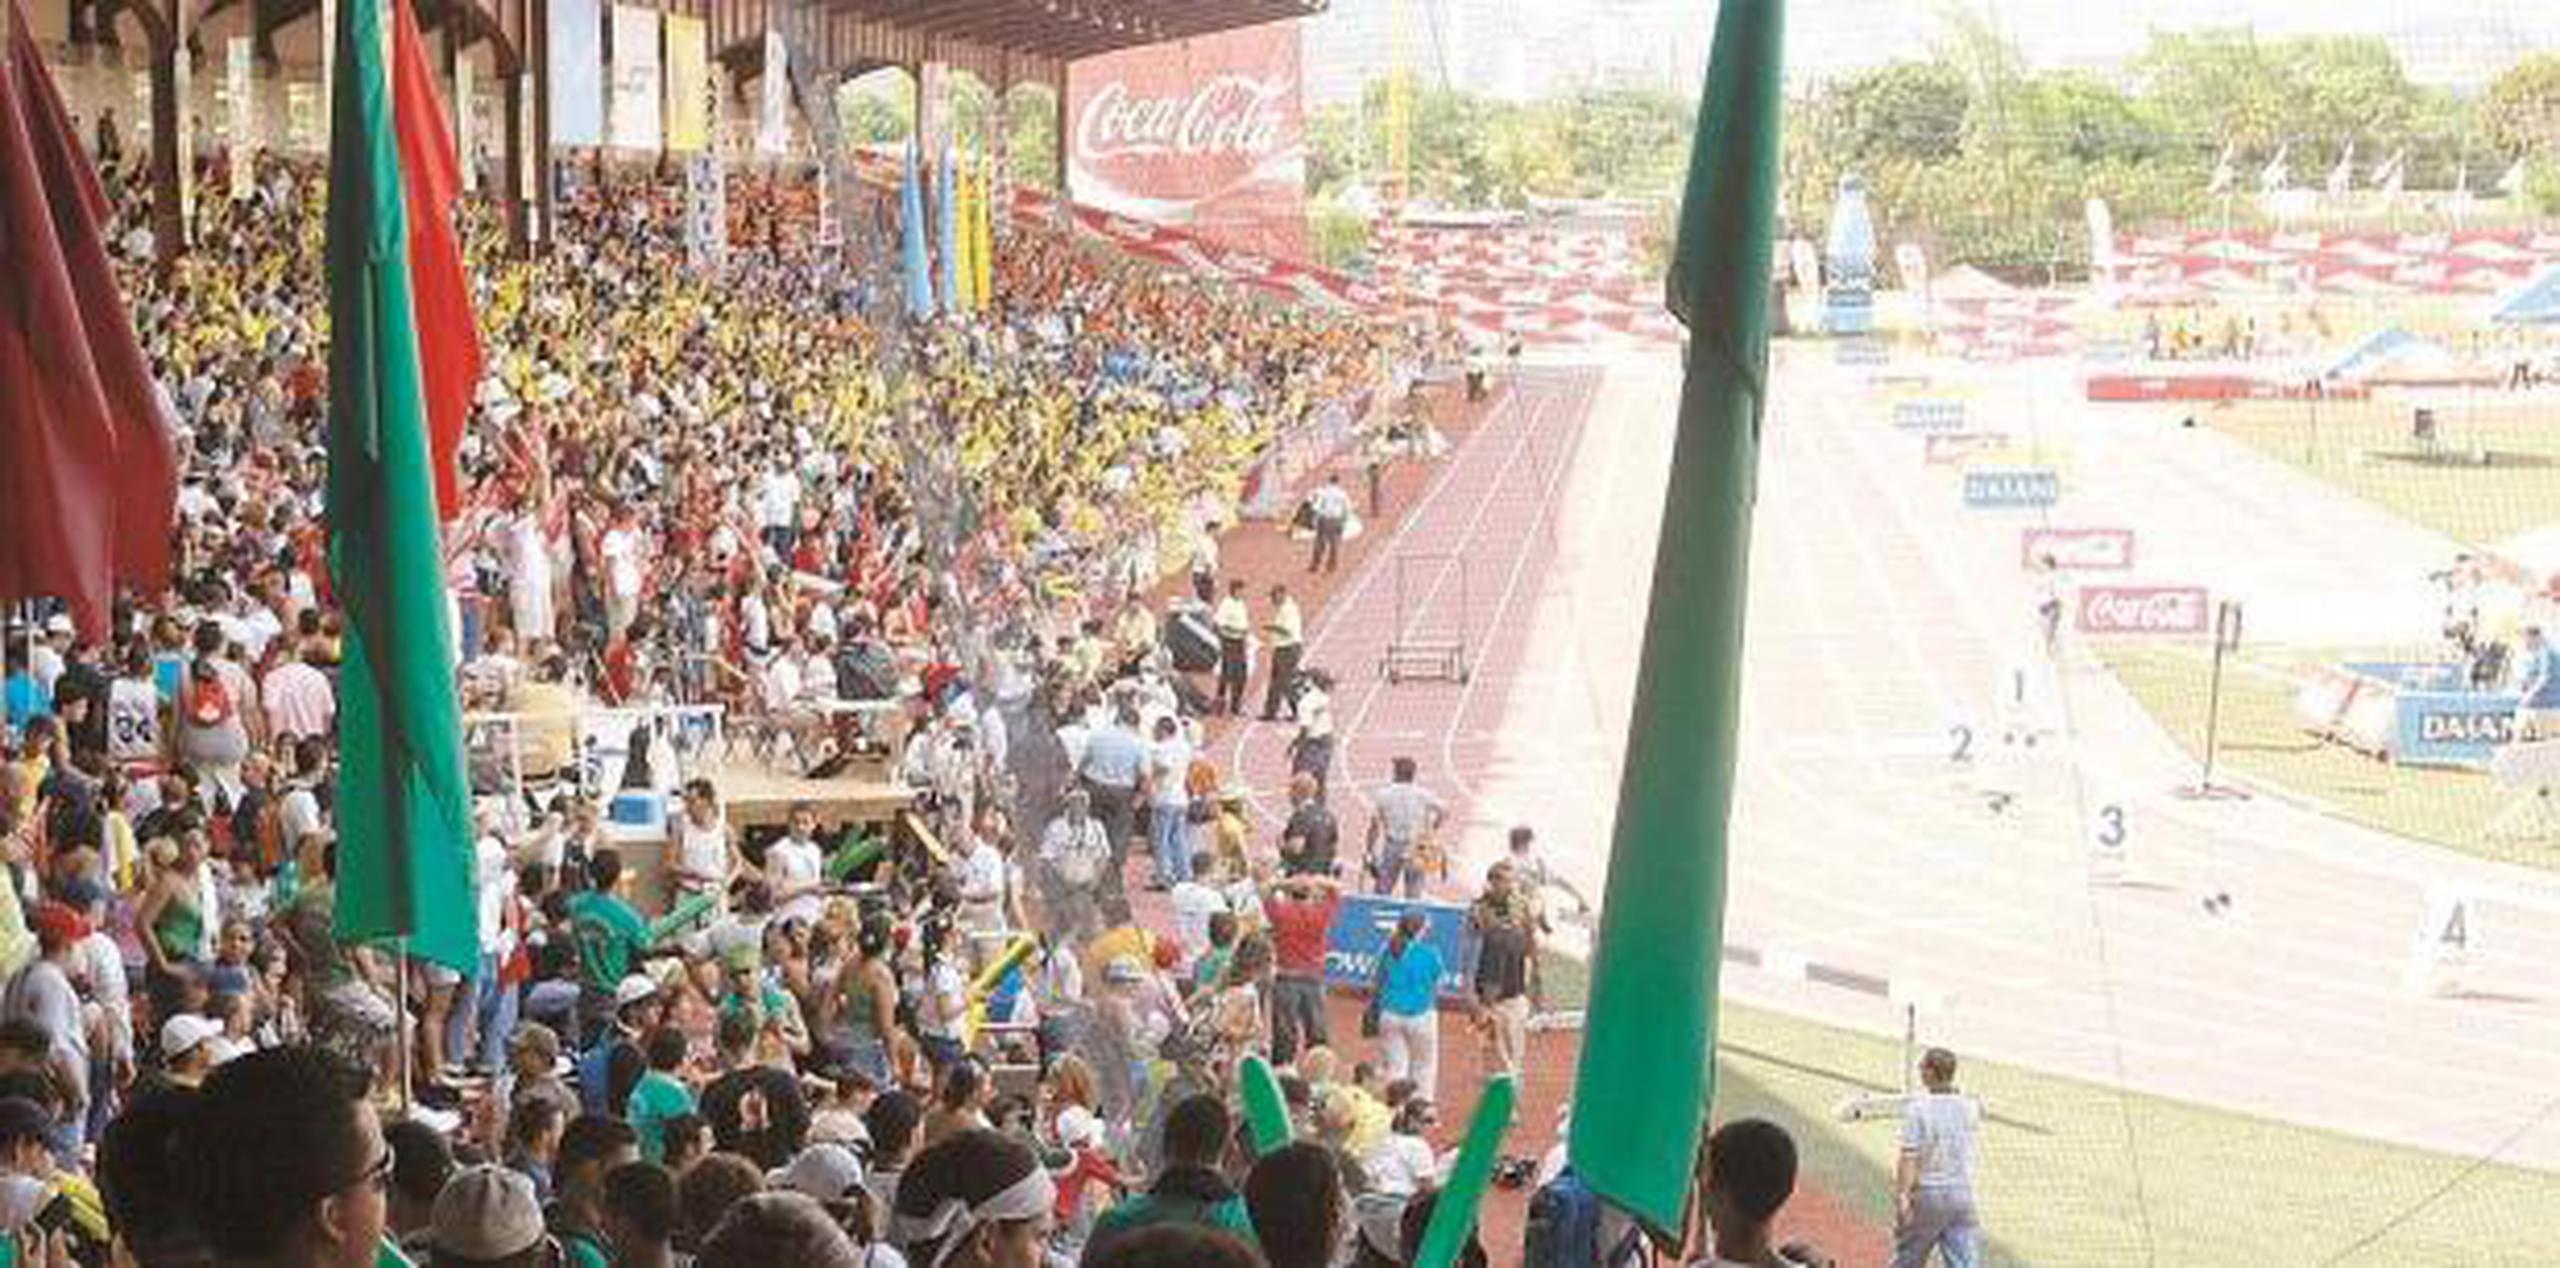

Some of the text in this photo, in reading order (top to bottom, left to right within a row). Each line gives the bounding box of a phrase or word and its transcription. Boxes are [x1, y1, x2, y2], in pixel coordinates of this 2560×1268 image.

[2014, 668, 2024, 702] 1
[1950, 725, 1973, 762] 2
[2420, 713, 2520, 743] DASAN
[2098, 805, 2126, 847] 3
[2439, 897, 2467, 950] 4
